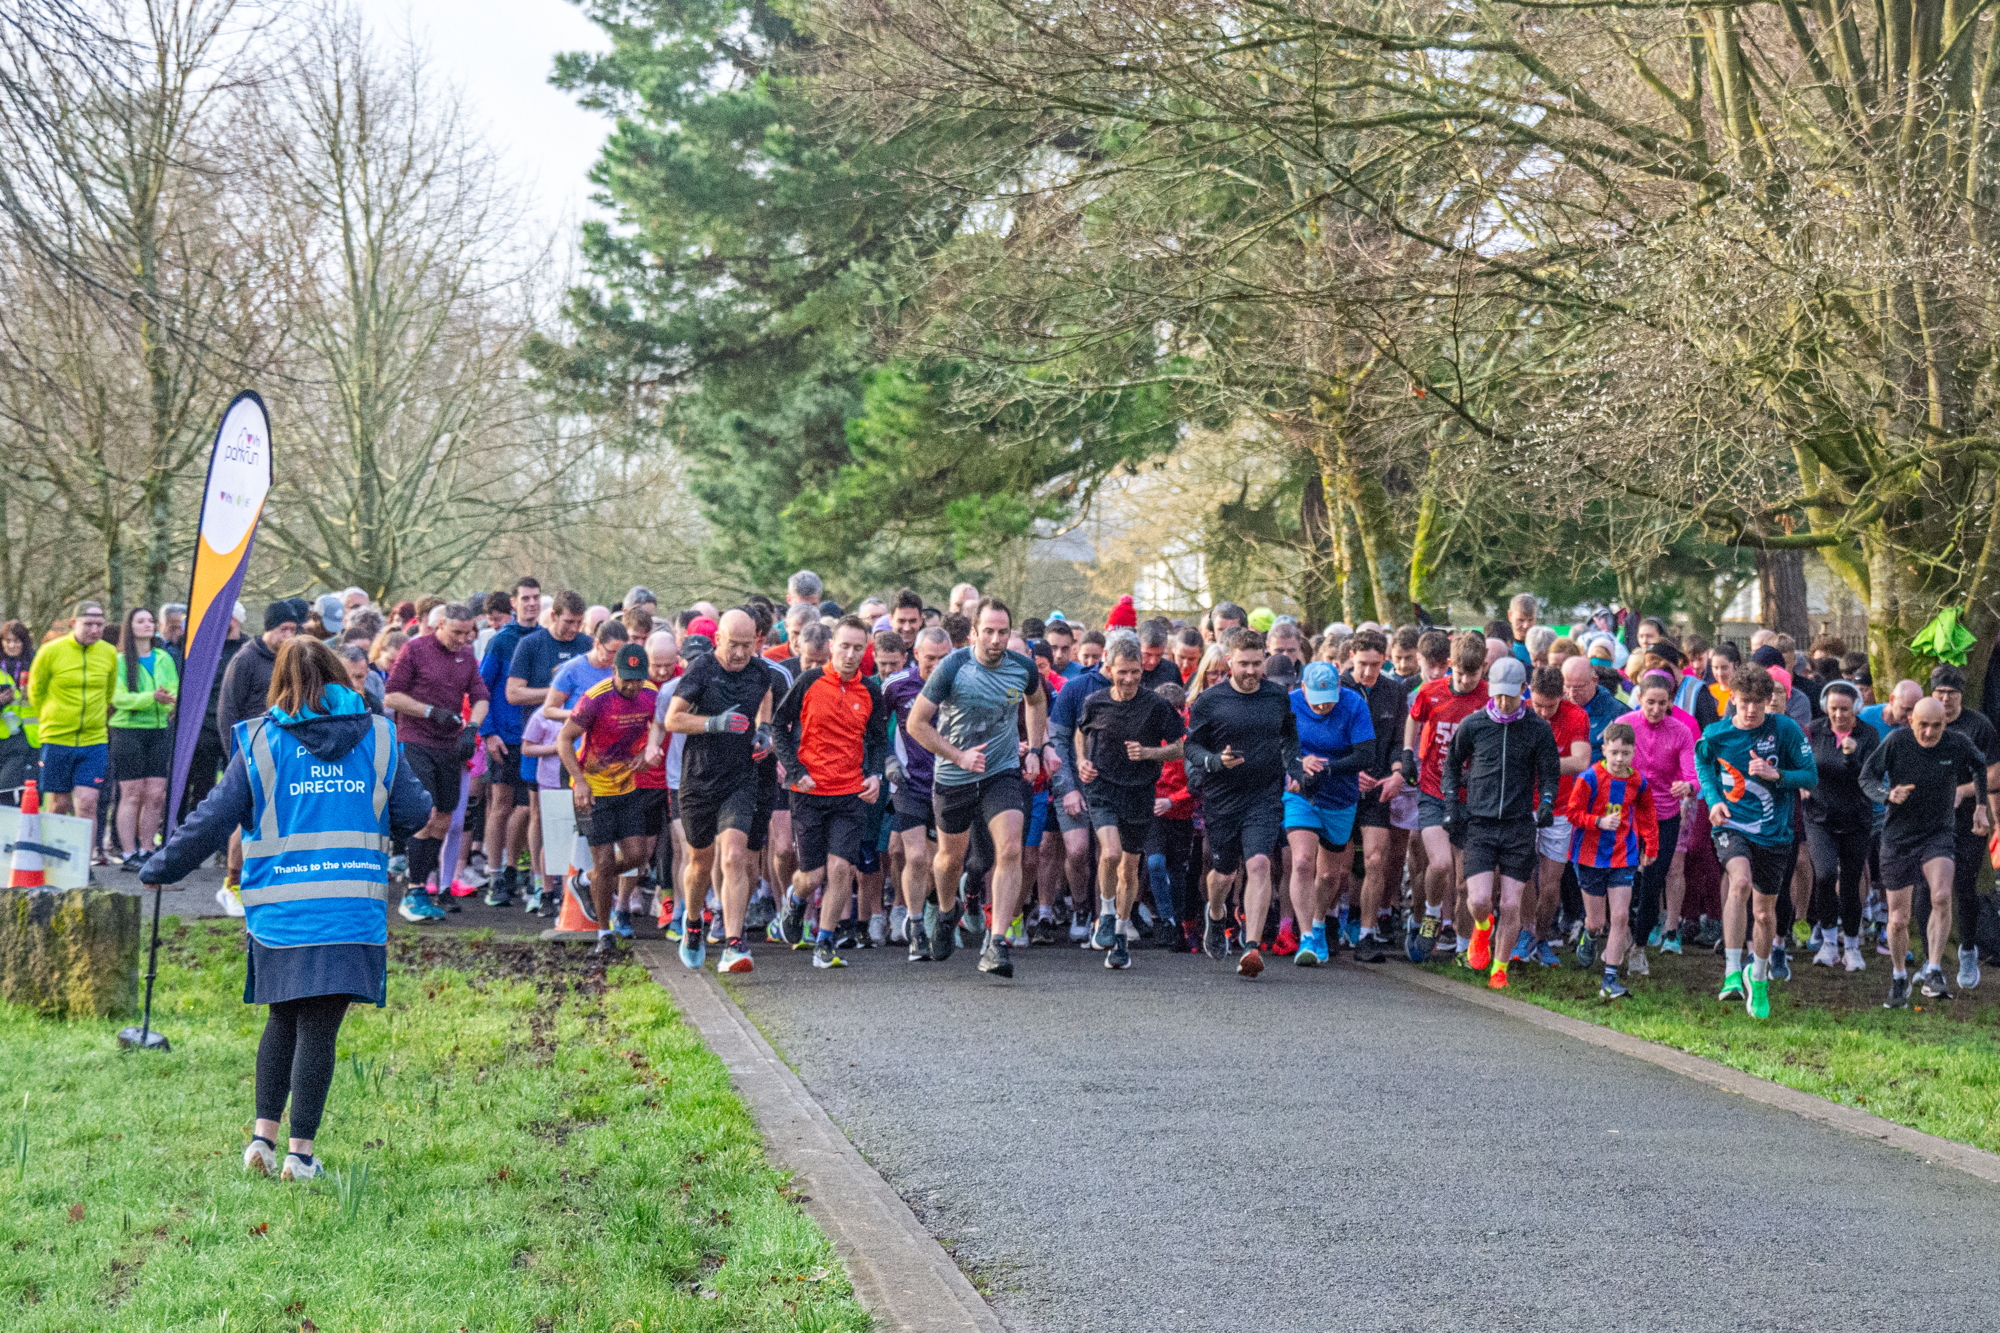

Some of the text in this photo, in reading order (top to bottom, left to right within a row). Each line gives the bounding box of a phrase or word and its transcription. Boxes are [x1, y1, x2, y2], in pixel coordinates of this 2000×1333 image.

[224, 445, 259, 466] parkrun
[310, 764, 344, 777] RUN
[289, 779, 366, 796] DIRECTOR
[273, 861, 381, 874] Thanks to the volunteers
